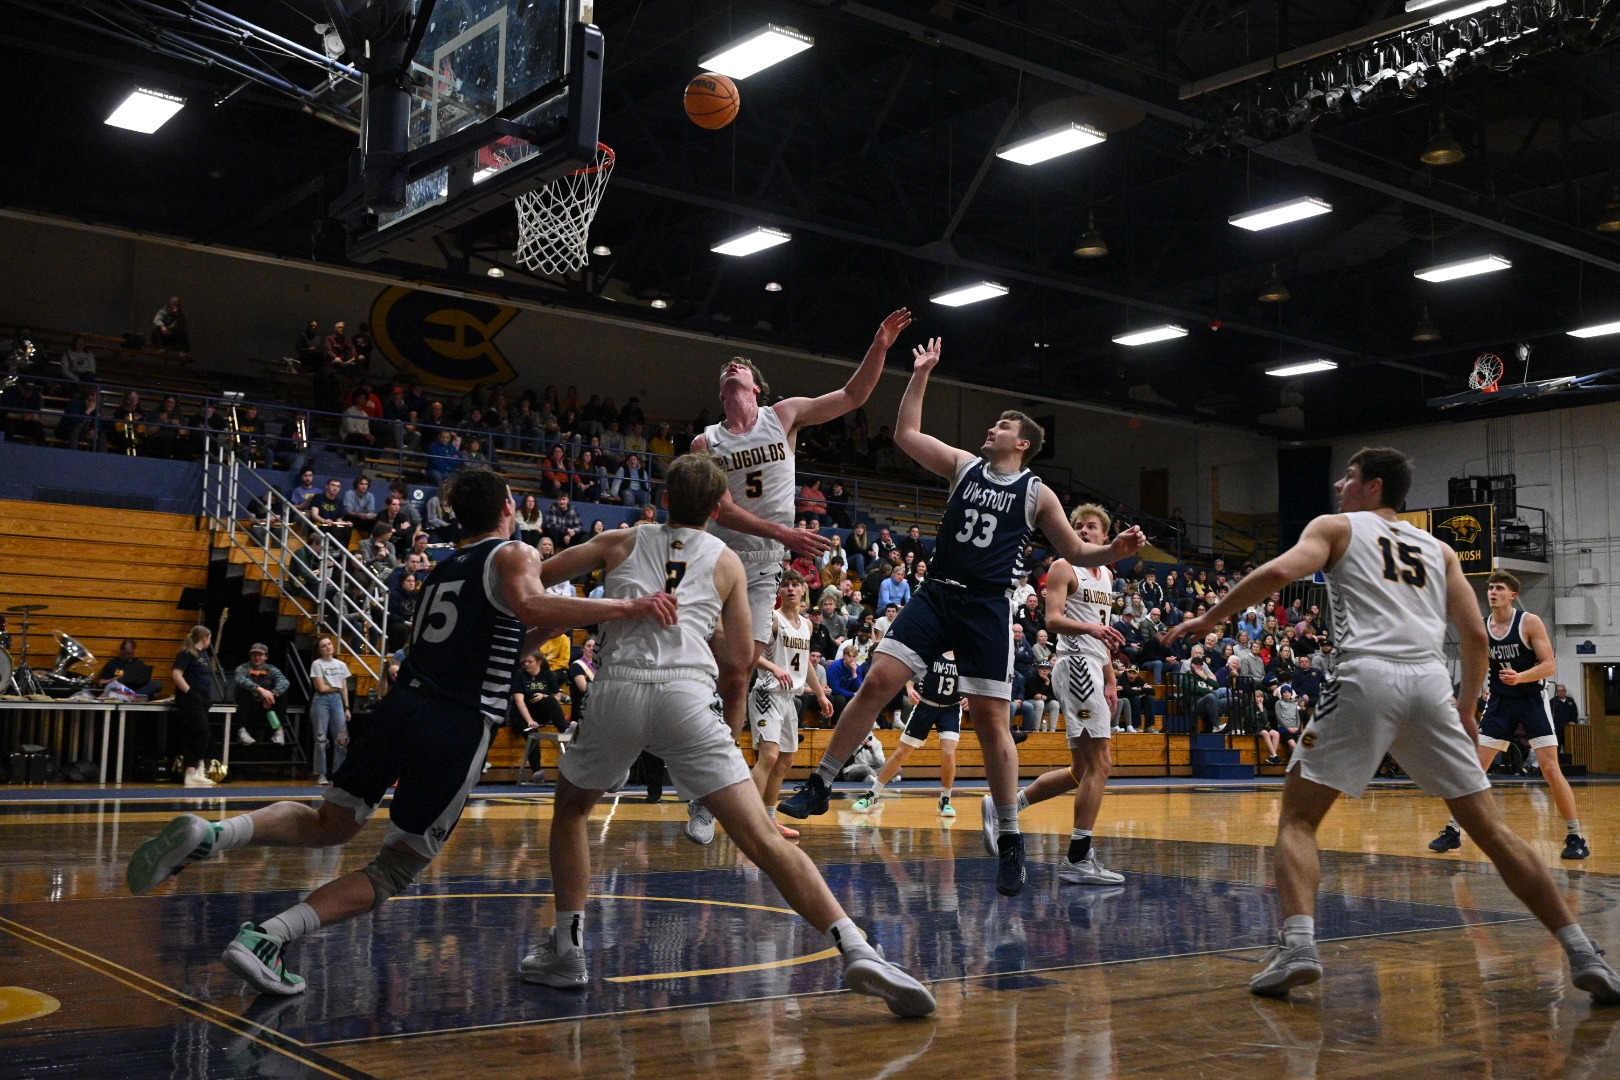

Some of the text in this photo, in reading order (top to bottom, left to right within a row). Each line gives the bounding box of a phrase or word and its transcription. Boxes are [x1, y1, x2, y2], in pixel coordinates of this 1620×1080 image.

[745, 469, 764, 499] 5
[962, 480, 1017, 513] UW-STOUT
[955, 508, 998, 548] 33
[1377, 535, 1426, 588] 15
[412, 579, 466, 644] 15
[790, 652, 800, 672] 4
[937, 675, 955, 696] 13
